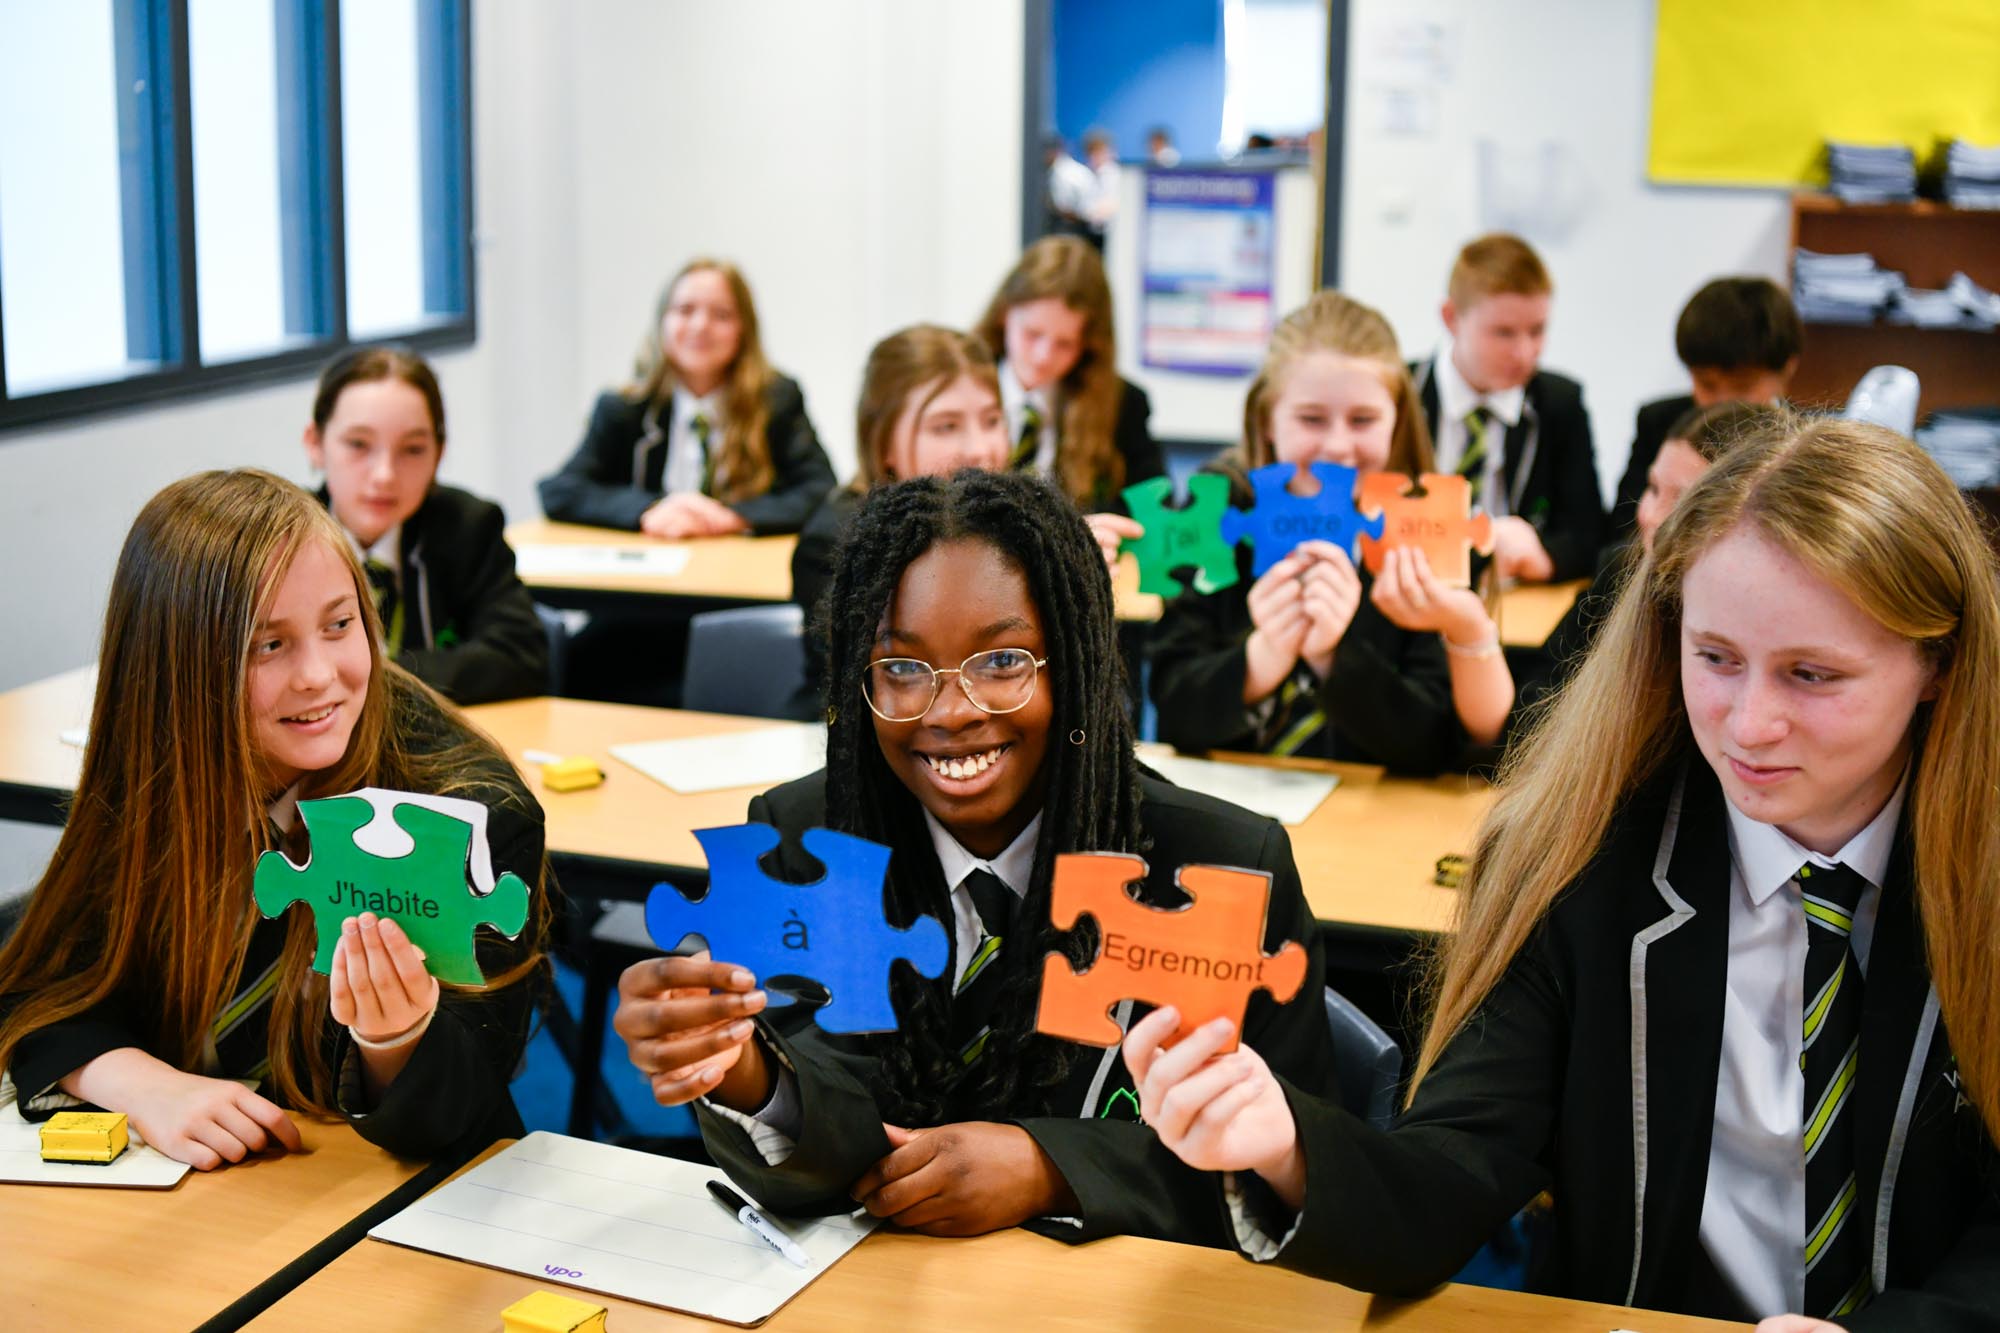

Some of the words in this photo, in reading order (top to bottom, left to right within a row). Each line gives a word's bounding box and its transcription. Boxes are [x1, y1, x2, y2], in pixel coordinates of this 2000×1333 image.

[1273, 516, 1343, 538] onze
[1399, 518, 1448, 538] ans
[328, 880, 440, 919] J'habite
[782, 908, 809, 952] à
[1103, 932, 1265, 982] Egremont
[544, 1264, 583, 1278] ypo
